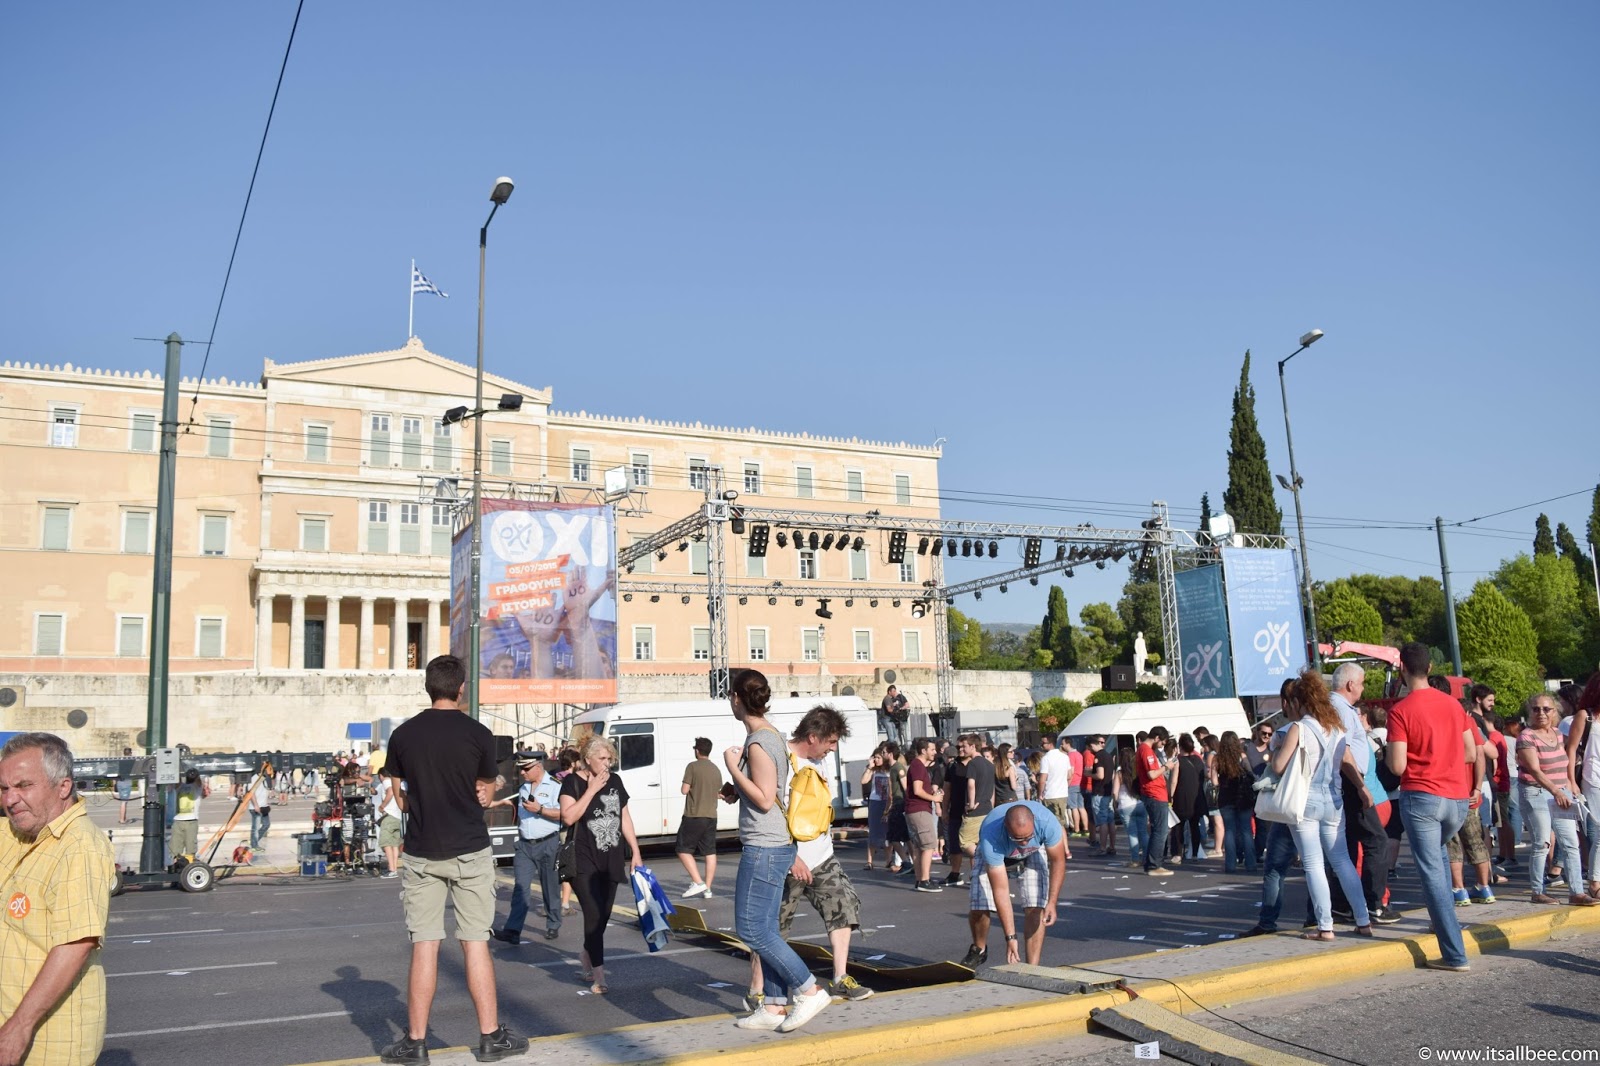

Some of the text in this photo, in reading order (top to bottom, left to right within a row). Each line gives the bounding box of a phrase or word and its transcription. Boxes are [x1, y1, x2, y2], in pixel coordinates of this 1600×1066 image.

[508, 562, 557, 575] 05/07/2015
[495, 577, 562, 596] ΓΡΑΦΟΥΜΕ
[501, 597, 551, 613] ΙΣΤΟΡΙΑ
